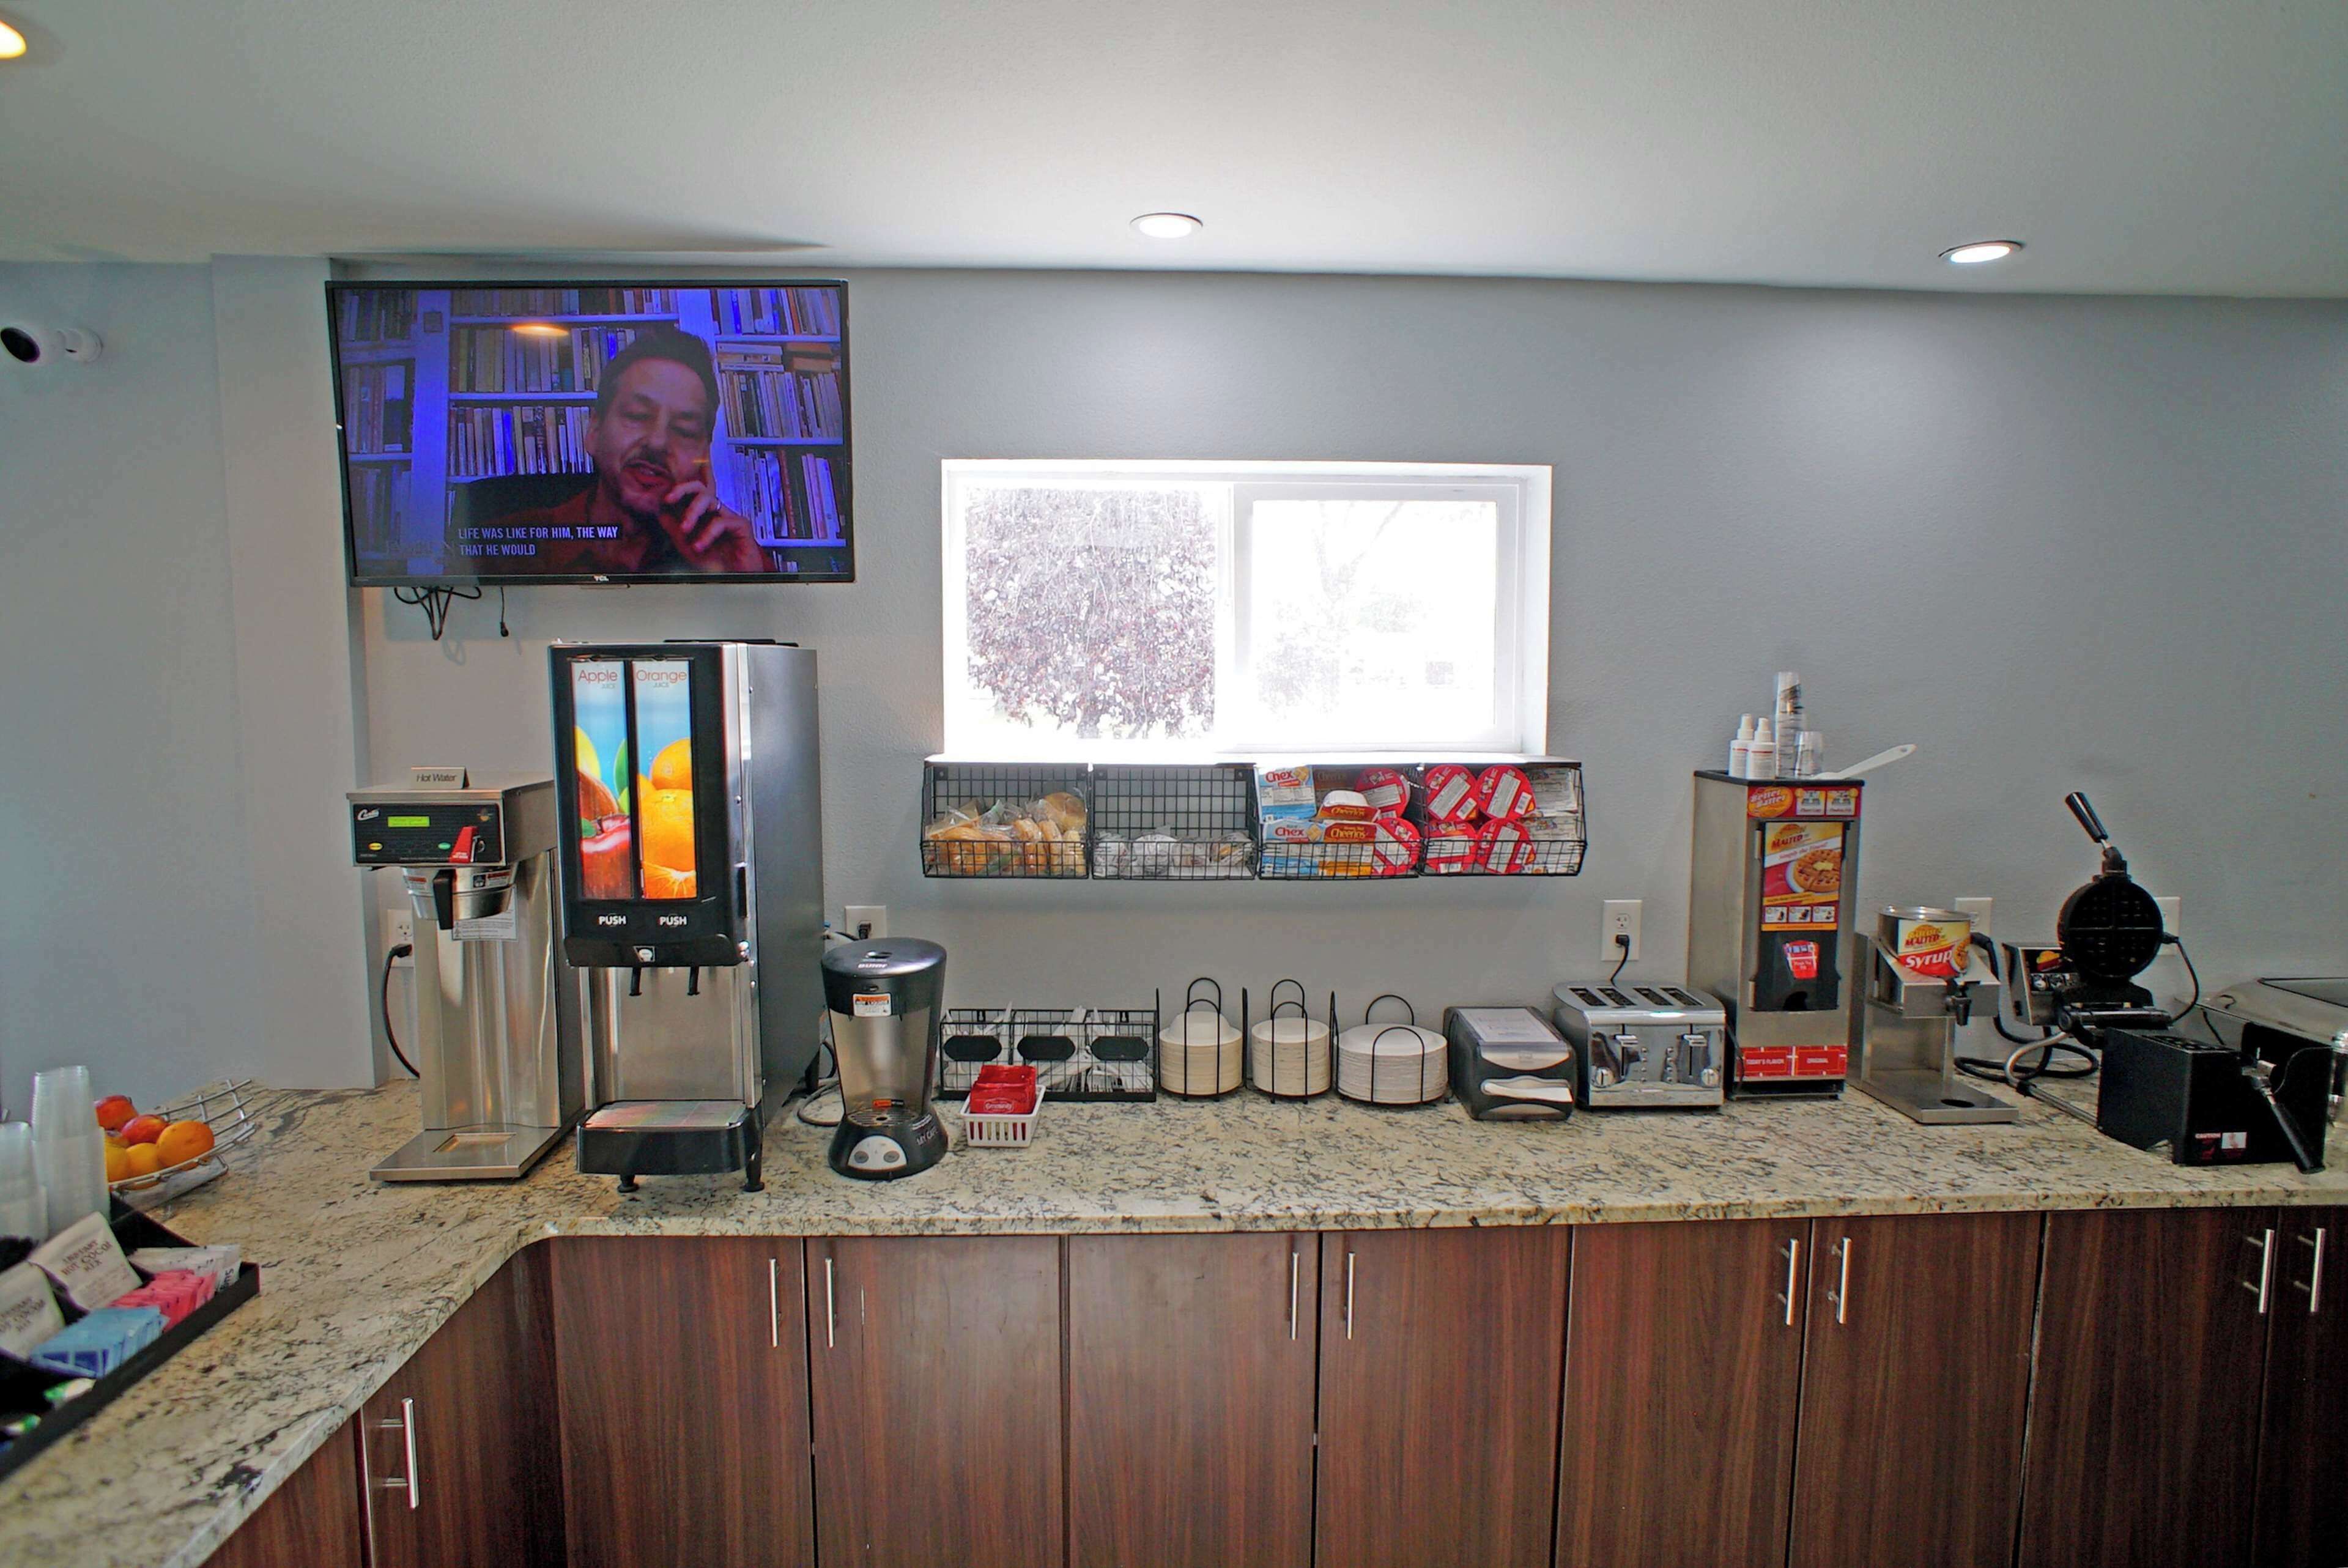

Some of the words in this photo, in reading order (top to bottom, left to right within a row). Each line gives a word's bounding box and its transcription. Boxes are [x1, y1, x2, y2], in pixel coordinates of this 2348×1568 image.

[459, 527, 479, 539] LIFE
[481, 527, 503, 539] WAS
[506, 527, 527, 538] LIKE
[530, 527, 549, 538] FOR
[552, 527, 574, 539] HIM,
[576, 527, 594, 538] THE
[597, 526, 618, 538] WAY
[460, 544, 483, 556] THAT
[486, 544, 498, 555] HE
[502, 544, 536, 555] WOULD
[577, 670, 618, 684] Apple
[636, 670, 687, 684] Orange
[417, 773, 431, 782] Hot
[432, 773, 457, 782] Water
[1265, 770, 1292, 783] Chex
[1275, 827, 1305, 837] Chex
[1330, 828, 1366, 839] Cheerios
[598, 915, 627, 925] PUSH
[659, 916, 687, 926] PUSH
[1905, 950, 1953, 969] Syrup
